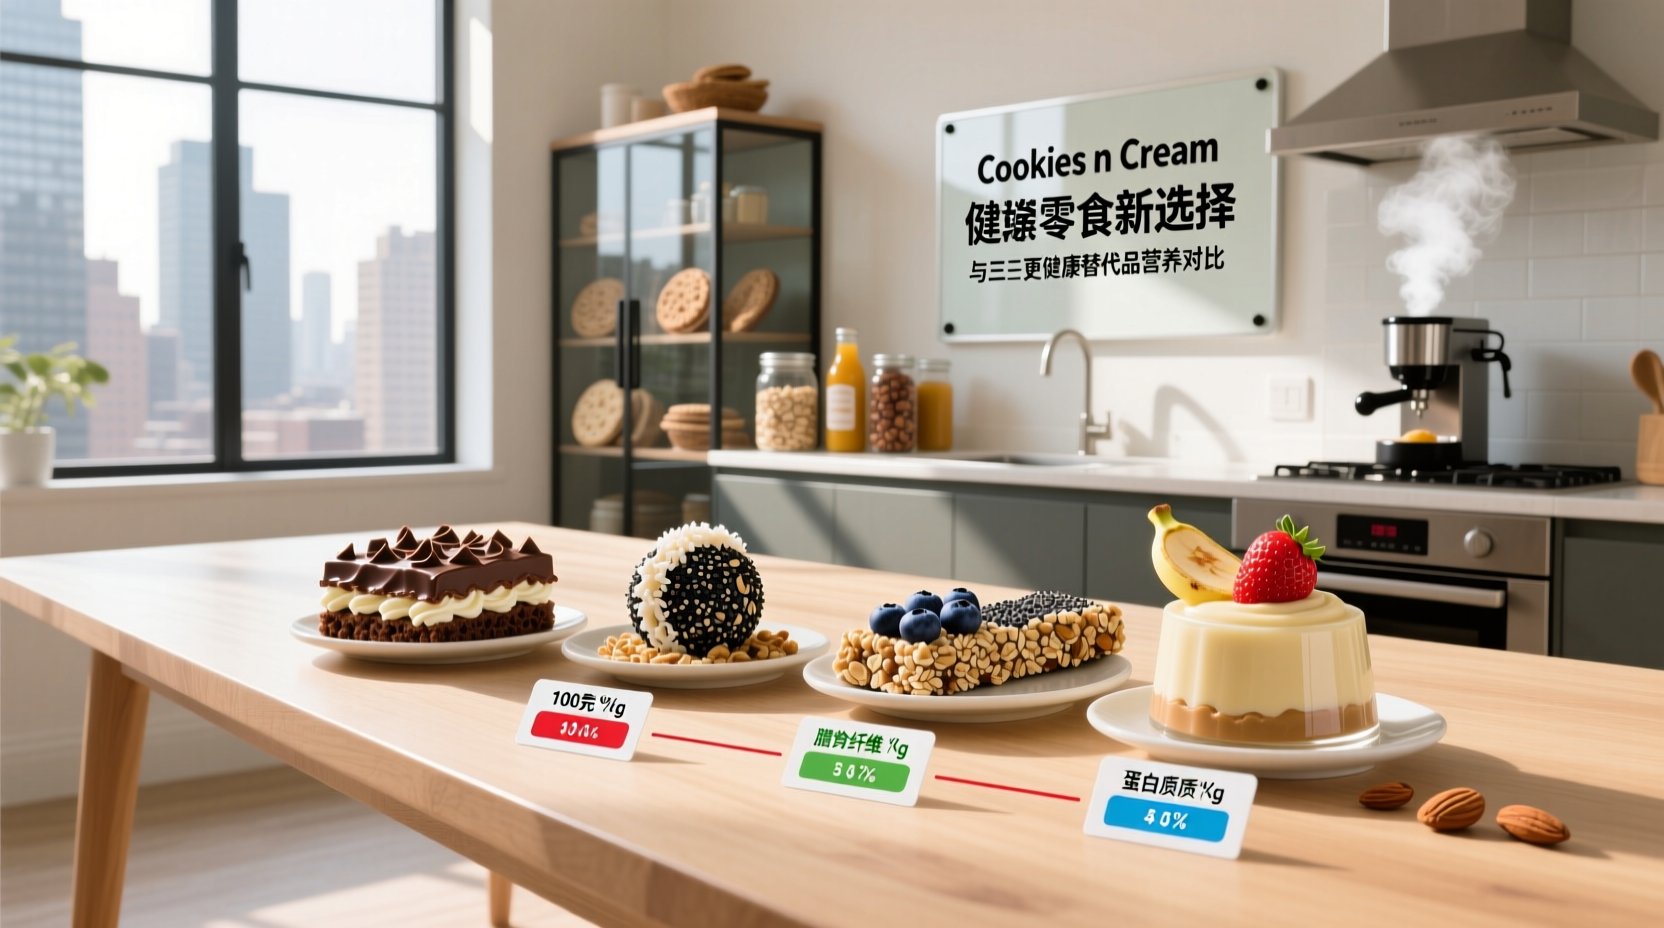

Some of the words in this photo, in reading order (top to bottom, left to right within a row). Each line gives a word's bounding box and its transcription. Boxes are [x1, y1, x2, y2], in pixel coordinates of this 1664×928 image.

[977, 146, 1087, 185] Cookies
[1094, 149, 1112, 174] n
[1119, 137, 1219, 171] Cream
